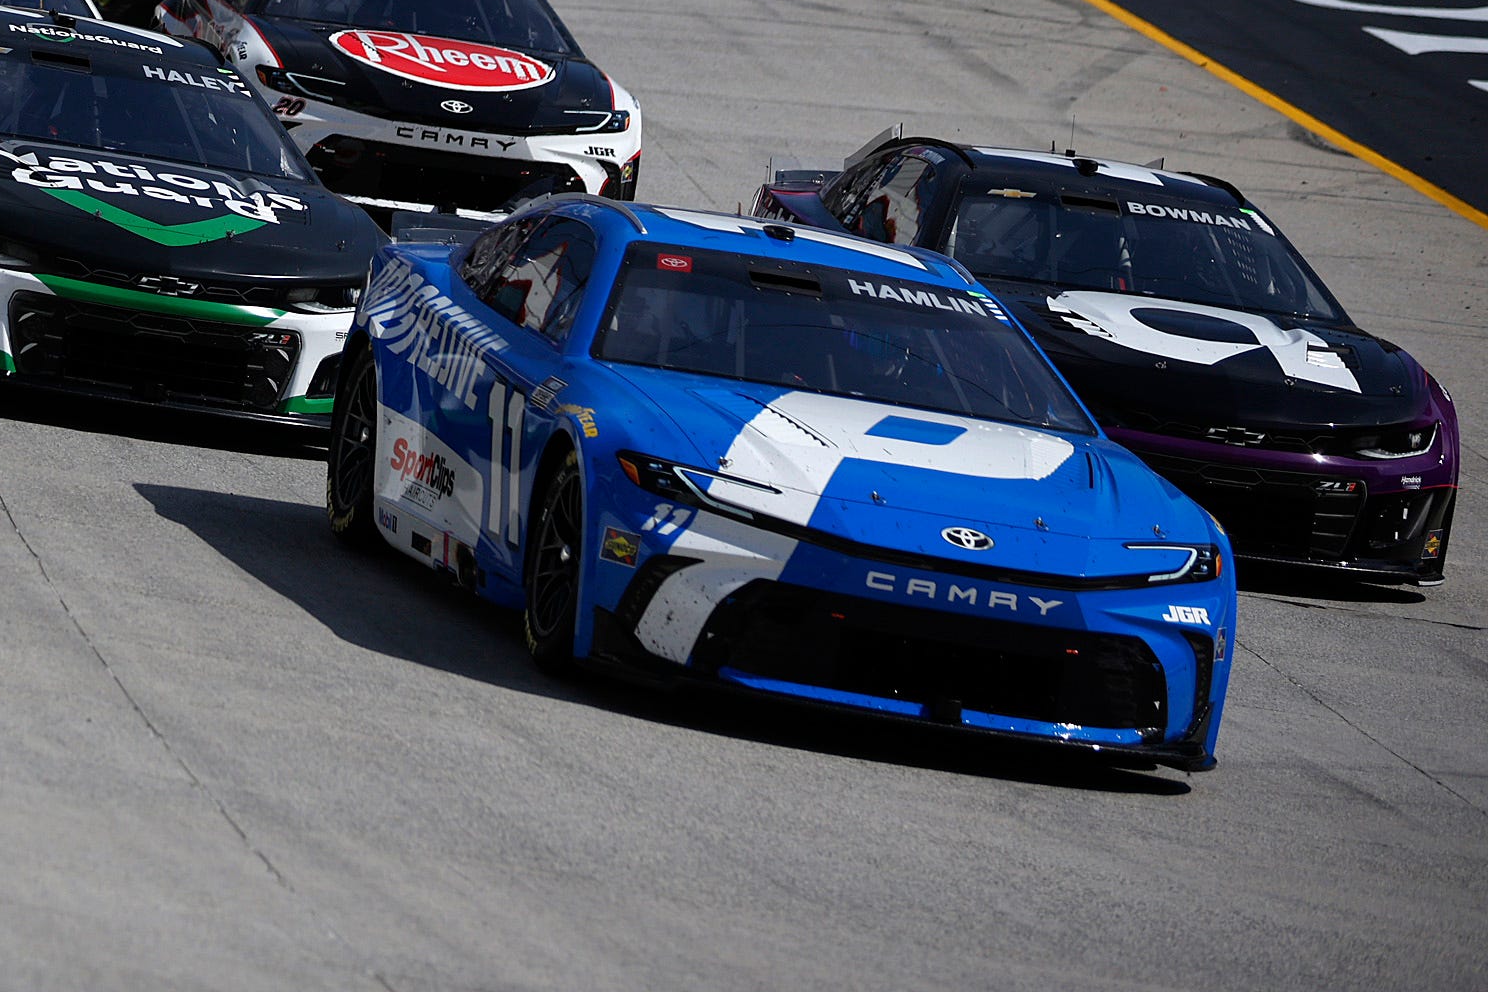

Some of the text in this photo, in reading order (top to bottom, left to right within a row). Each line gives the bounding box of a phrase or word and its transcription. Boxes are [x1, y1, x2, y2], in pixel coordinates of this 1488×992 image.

[8, 22, 164, 56] NationsGuard
[359, 30, 544, 84] Rheem
[143, 65, 238, 95] HALEY
[273, 96, 308, 117] 20
[396, 125, 517, 153] CAMRY
[582, 145, 617, 159] JGR
[11, 164, 280, 225] Guard
[1126, 199, 1252, 233] BOWMAN
[847, 277, 989, 318] HAMLIN
[356, 257, 511, 411] PROGRESSIVE
[390, 437, 456, 499] SportClips
[488, 380, 526, 547] 11
[640, 503, 692, 536] 11
[865, 570, 1064, 617] CAMRY
[1162, 604, 1212, 626] JGR
